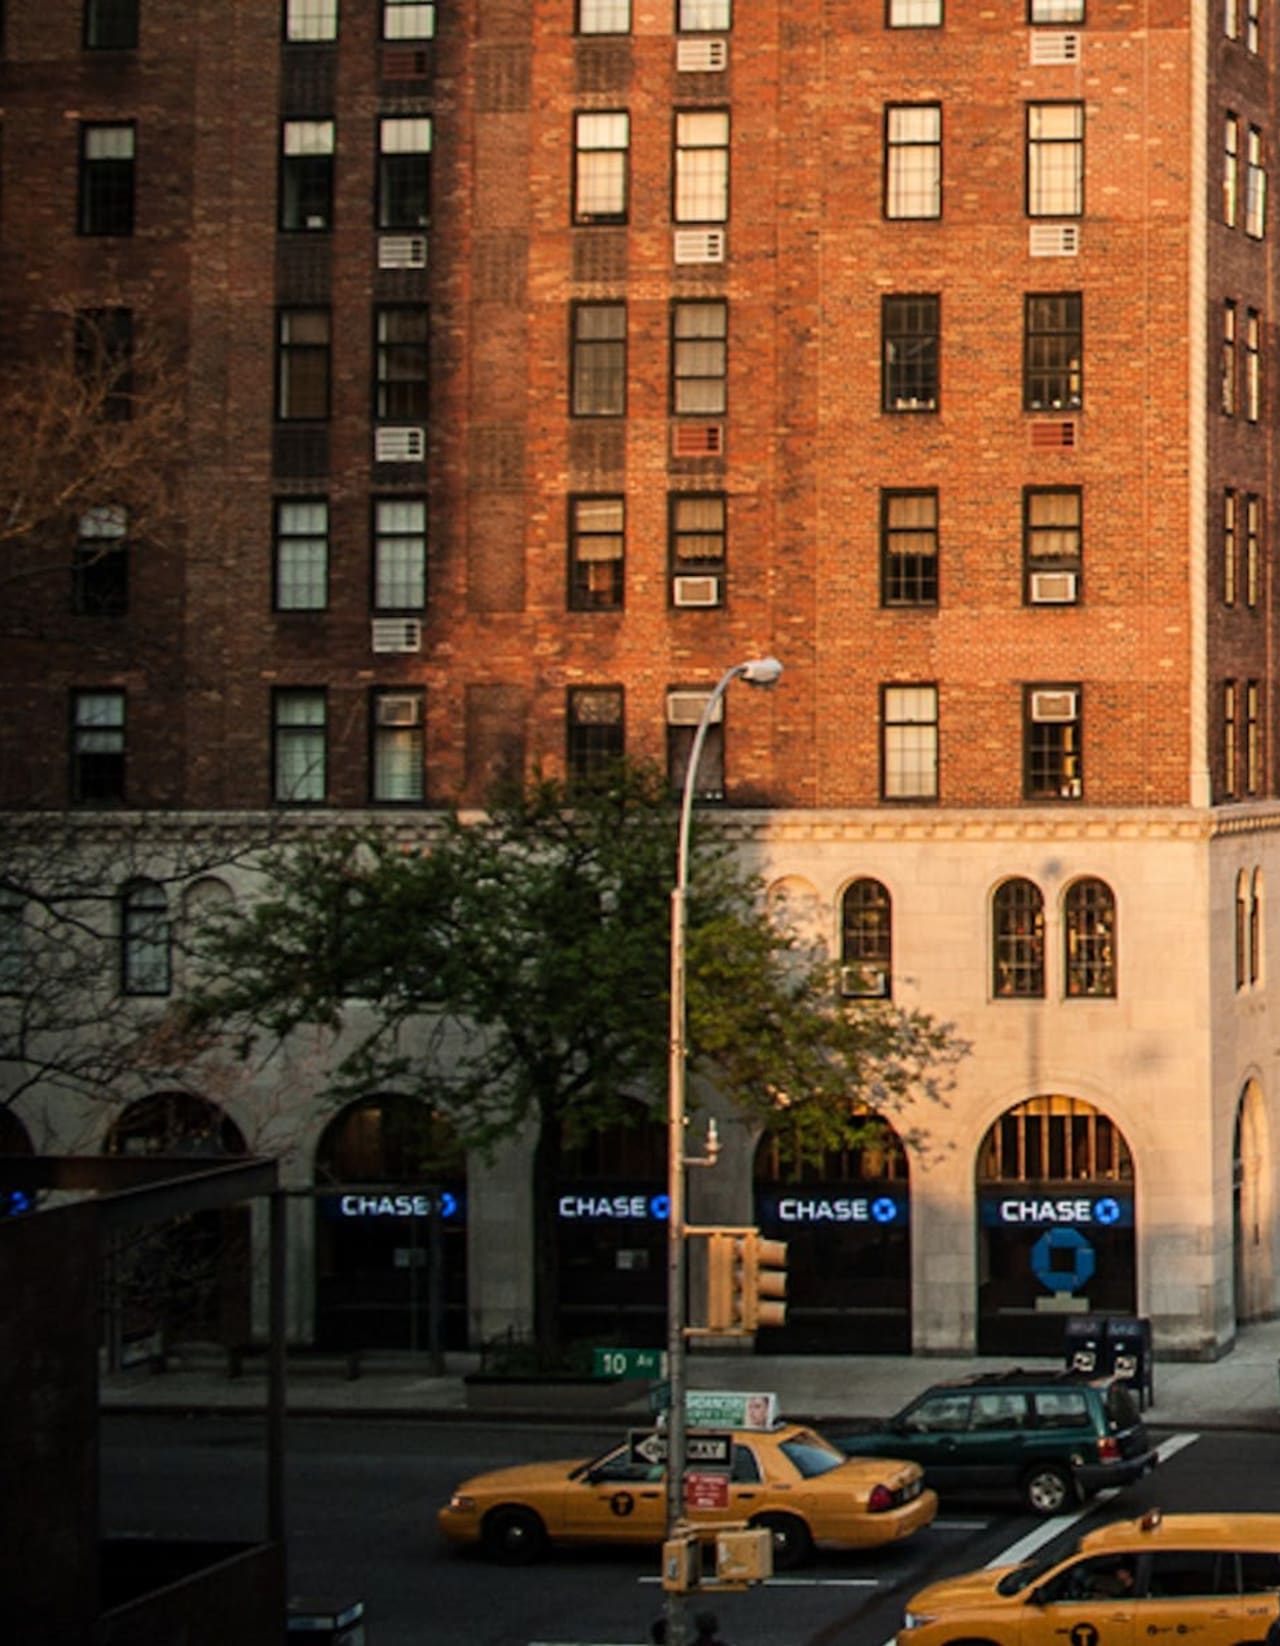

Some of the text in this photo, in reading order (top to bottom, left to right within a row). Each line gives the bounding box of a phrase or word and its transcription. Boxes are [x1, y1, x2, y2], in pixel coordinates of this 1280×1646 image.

[341, 1194, 431, 1217] CHASE
[558, 1195, 648, 1218] CHASE
[778, 1198, 870, 1221] CHASE
[1000, 1200, 1092, 1222] CHASE
[602, 1353, 654, 1375] 10 Av
